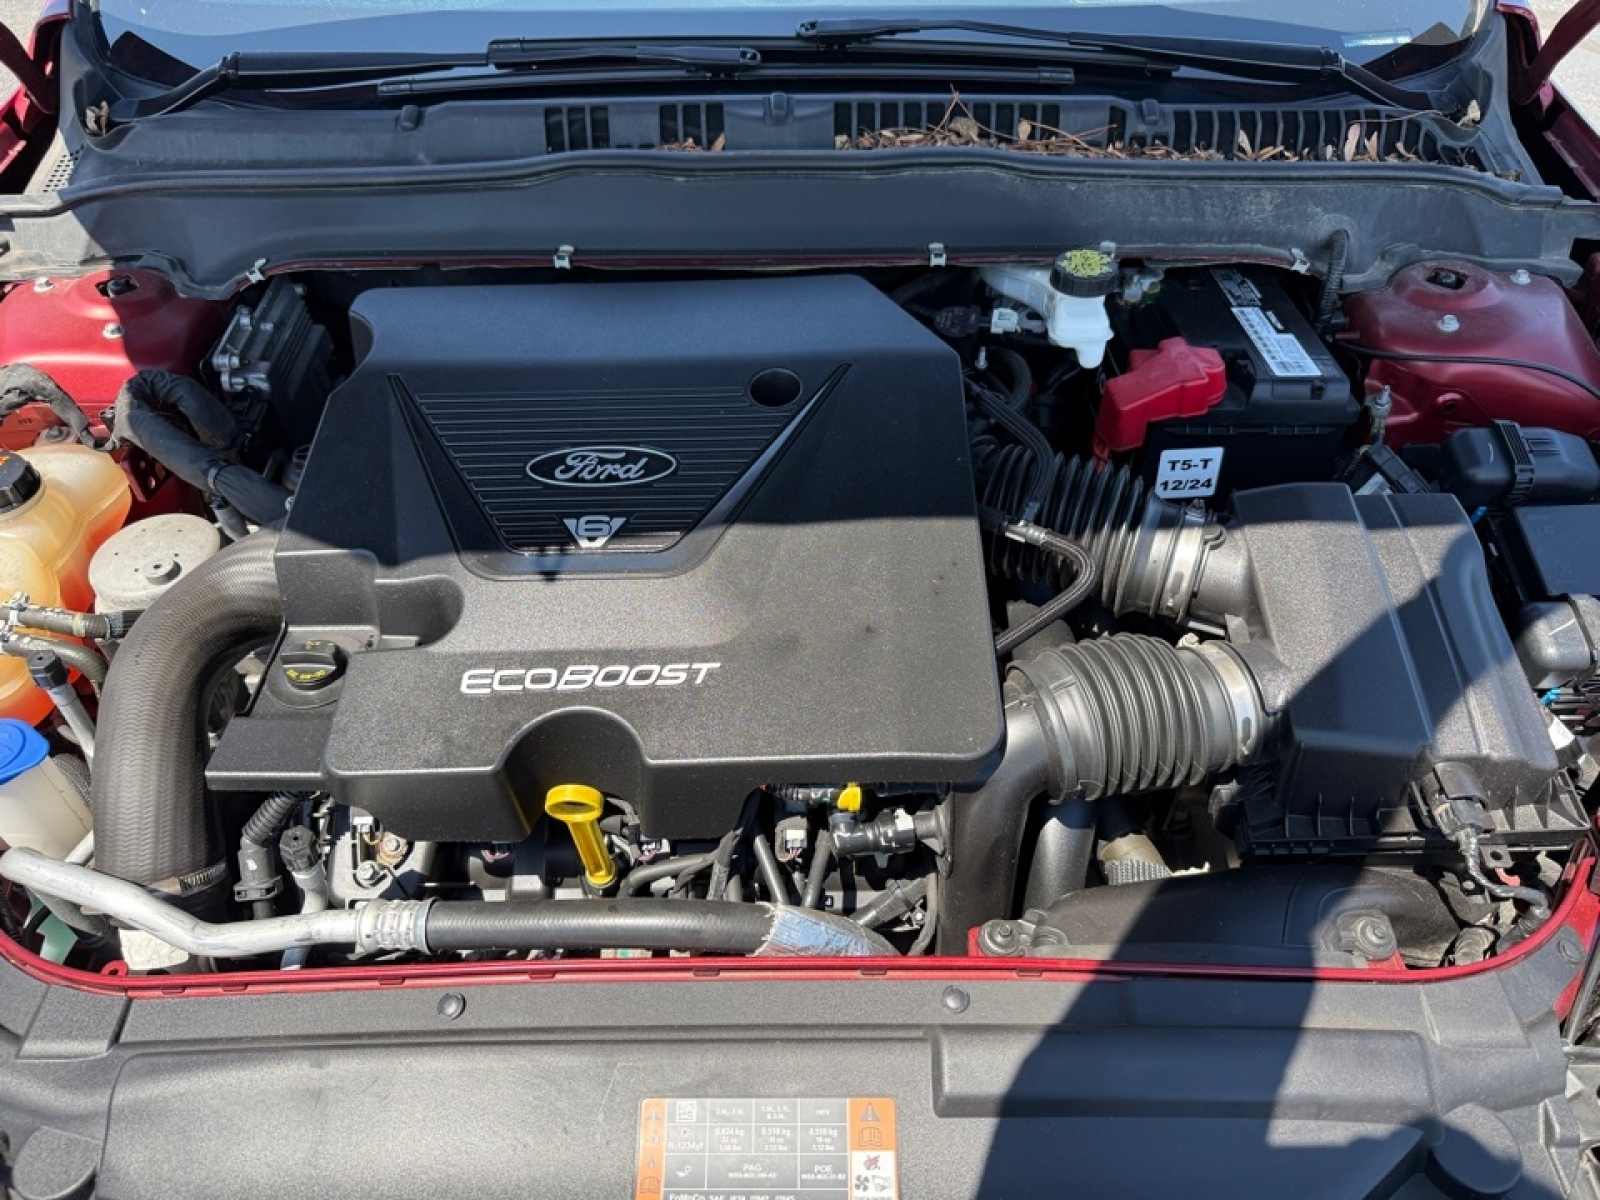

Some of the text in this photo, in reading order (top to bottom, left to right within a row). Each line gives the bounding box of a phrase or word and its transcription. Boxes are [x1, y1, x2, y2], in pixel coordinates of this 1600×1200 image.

[554, 451, 649, 480] Ford
[1167, 457, 1214, 471] T5-T
[1160, 478, 1212, 491] 12/24
[562, 514, 628, 549] V6
